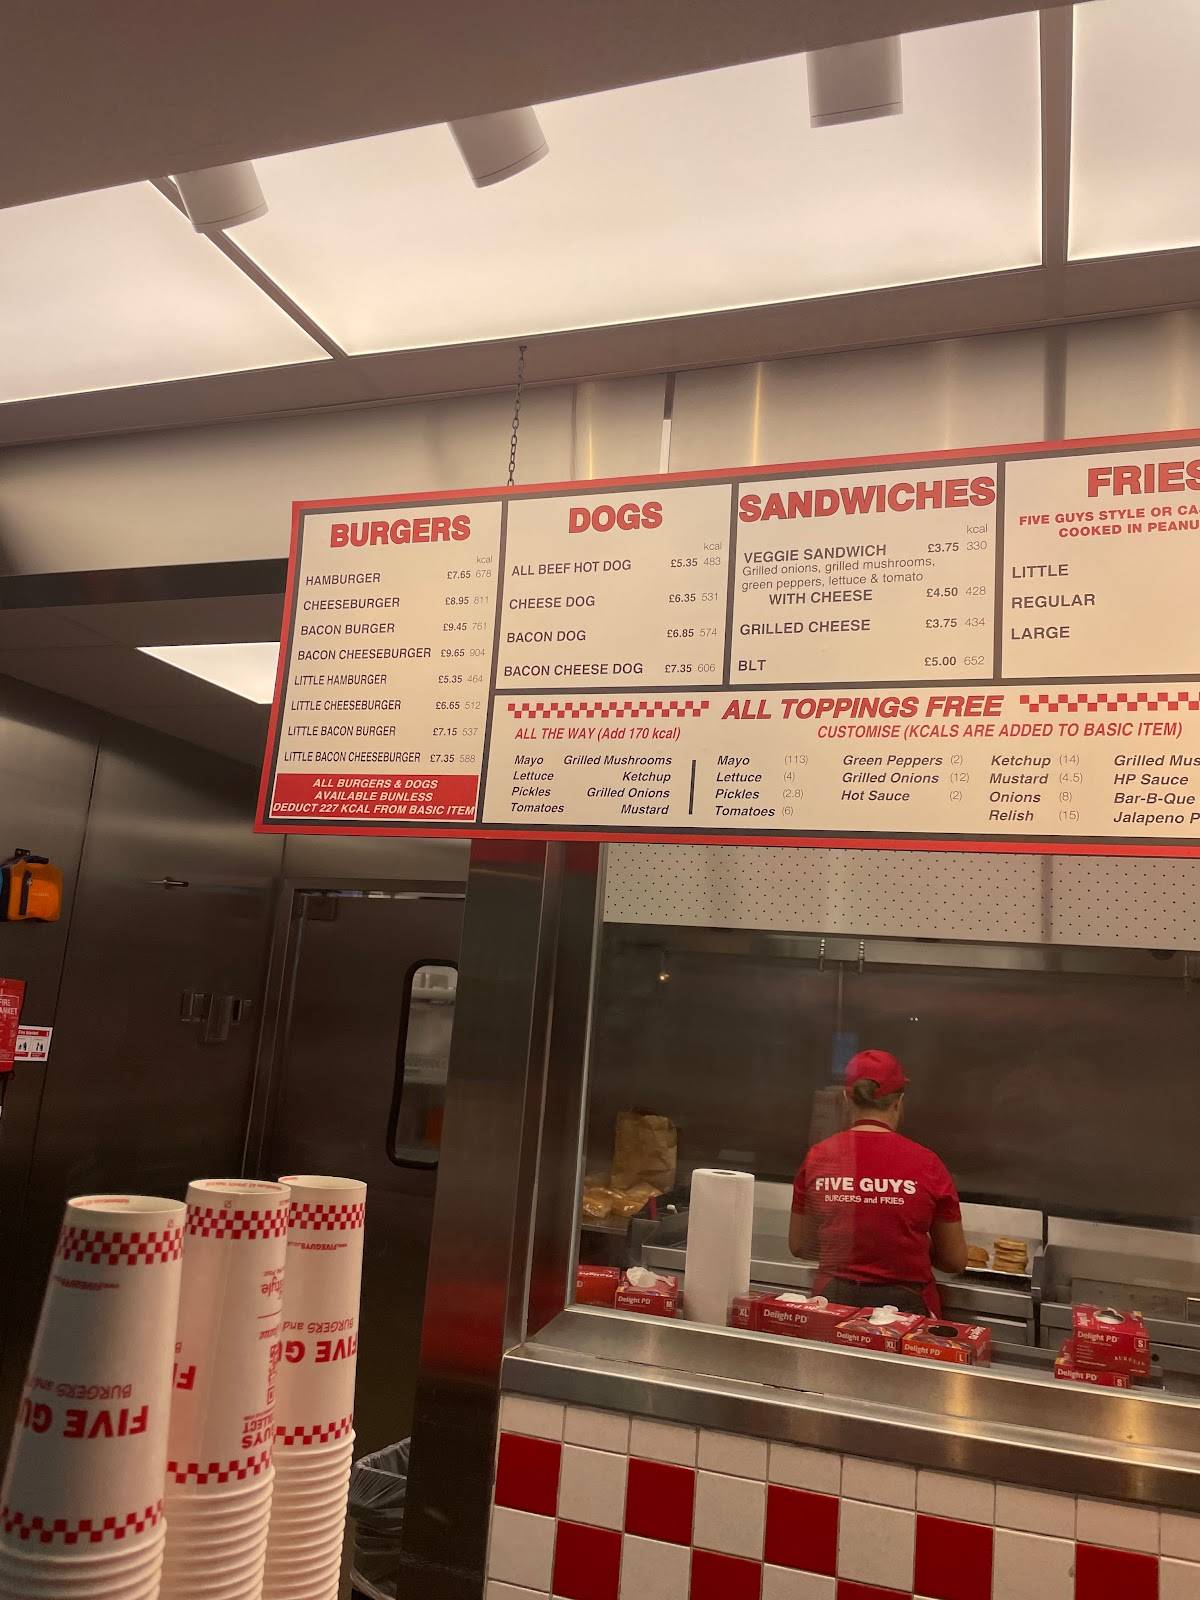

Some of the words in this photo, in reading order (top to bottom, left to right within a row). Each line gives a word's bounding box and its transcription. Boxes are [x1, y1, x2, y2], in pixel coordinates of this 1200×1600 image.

[738, 476, 996, 522] SANDWICHES
[569, 501, 663, 534] DOGS
[1019, 515, 1050, 525] FIVE
[1055, 512, 1094, 523] GUYS
[1099, 508, 1145, 520] STYLE
[1151, 507, 1172, 517] OR
[1178, 505, 1200, 515] CA
[330, 514, 471, 548] BURGERS
[1059, 525, 1121, 537] COOKED
[1128, 524, 1142, 533] IN
[744, 550, 799, 564] VEGGIE
[804, 544, 886, 560] SANDWICH
[927, 542, 959, 552] £3.75
[967, 541, 987, 550] 330
[512, 566, 534, 576] ALL
[538, 563, 571, 575] BEEF
[574, 562, 599, 573] HOT
[603, 560, 631, 571] DOG
[670, 559, 697, 568] £5.35
[743, 564, 778, 576] Grilled
[781, 563, 821, 574] onions,
[825, 561, 859, 574] grilled
[863, 558, 935, 570] mushrooms,
[1012, 564, 1069, 578] LITTLE
[305, 573, 381, 586] HAMBURGER
[447, 571, 471, 580] £7.65
[742, 579, 773, 592] green
[777, 577, 824, 590] peppers,
[828, 575, 867, 585] lettuce
[870, 574, 879, 584] &
[883, 572, 923, 582] tomato
[509, 598, 561, 609] CHEESE
[566, 596, 595, 607] DOG
[669, 594, 696, 603] £6.35
[769, 592, 806, 605] WITH
[810, 590, 873, 603] CHEESE
[926, 587, 958, 597] £4.50
[966, 586, 986, 596] 428
[1012, 594, 1096, 609] REGULAR
[303, 598, 400, 611] CHEESEBURGER
[446, 597, 469, 605] £8.95
[301, 625, 341, 636] BACON
[345, 623, 395, 634] BURGER
[443, 623, 467, 631] £9.45
[740, 622, 803, 635] GRILLED
[808, 620, 871, 632] CHEESE
[925, 619, 957, 628] £3.75
[965, 617, 985, 627] 434
[507, 632, 553, 643] BACON
[557, 630, 586, 642] DOG
[667, 629, 694, 638] £6.85
[1011, 626, 1070, 640] LARGE
[298, 650, 335, 660] BACON
[339, 648, 431, 659] CHEESEBURGER
[441, 649, 465, 657] £9.65
[504, 666, 550, 677] BACON
[554, 664, 608, 675] CHEESE
[613, 663, 643, 674] DOG
[665, 664, 692, 673] £7.35
[738, 660, 766, 671] BLT
[924, 656, 956, 666] £5.00
[964, 656, 985, 665] 652
[294, 675, 324, 685] LITTLE
[326, 675, 387, 684] HAMBURGER
[438, 675, 463, 684] £5.35
[721, 700, 772, 720] ALL
[781, 697, 919, 719] TOPPINGS
[926, 695, 1004, 717] FREE
[515, 728, 537, 740] ALL
[541, 728, 564, 739] THE
[568, 728, 596, 739] WAY
[597, 728, 626, 742] (Add
[629, 728, 649, 739] 170
[652, 727, 681, 741] kcal)
[818, 725, 901, 738] CUSTOMISE
[904, 724, 959, 740] (KCALS
[963, 724, 995, 737] ARE
[999, 724, 1053, 737] ADDED
[1058, 723, 1079, 736] TO
[1084, 723, 1133, 736] BASIC
[1138, 722, 1182, 739] ITEM)
[284, 752, 313, 762] LITTLE
[315, 752, 346, 762] BACON
[349, 752, 420, 762] CHEESEBURGER
[430, 754, 455, 763] £7.35
[717, 755, 750, 768] Mayo
[843, 755, 882, 766] Green
[886, 755, 943, 768] Peppers
[950, 755, 962, 765] (2)
[991, 755, 1051, 768] Ketchup
[1059, 755, 1080, 765] (14)
[1114, 755, 1164, 766] Grilled
[716, 772, 762, 782] Lettuce
[842, 773, 886, 783] Grilled
[890, 773, 939, 784] Onions
[950, 773, 970, 783] (12)
[990, 773, 1048, 784] Mustard
[1059, 773, 1083, 783] (4.5)
[1114, 774, 1136, 784] HP
[1140, 774, 1189, 785] Sauce
[312, 779, 334, 787] ALL
[337, 779, 391, 789] BURGERS
[394, 780, 402, 788] &
[405, 780, 438, 789] DOGS
[314, 791, 377, 800] AVAILABLE
[380, 792, 433, 802] BUNLESS
[715, 789, 760, 799] Pickles
[841, 790, 864, 800] Hot
[868, 791, 910, 801] Sauce
[950, 791, 962, 800] (2)
[990, 792, 1041, 803] Onions
[1114, 793, 1196, 804] Bar-B-Que
[272, 803, 317, 812] DEDUCT
[319, 803, 338, 812] 227
[340, 804, 371, 814] KCAL
[373, 804, 406, 814] FROM
[409, 806, 444, 815] BASIC
[447, 806, 474, 816] ITEM
[715, 806, 775, 817] Tomatoes
[989, 810, 1034, 821] Relish
[1114, 812, 1184, 826] Jalapeno
[815, 1177, 854, 1191] FIVE
[860, 1178, 916, 1194] GUYS
[618, 1296, 640, 1304] Delight
[740, 1309, 749, 1317] XL
[764, 1309, 792, 1321] Delight
[795, 1314, 807, 1323] PD
[282, 1321, 304, 1332] and
[308, 1317, 354, 1334] BURGERS
[837, 1331, 860, 1342] Delight
[1078, 1331, 1104, 1341] Delight
[316, 1335, 358, 1362] FIVE
[905, 1344, 928, 1354] Delight
[930, 1347, 941, 1356] PD
[1058, 1369, 1083, 1379] Delight
[57, 1383, 132, 1401] BURGERS
[63, 1405, 148, 1438] FIVE
